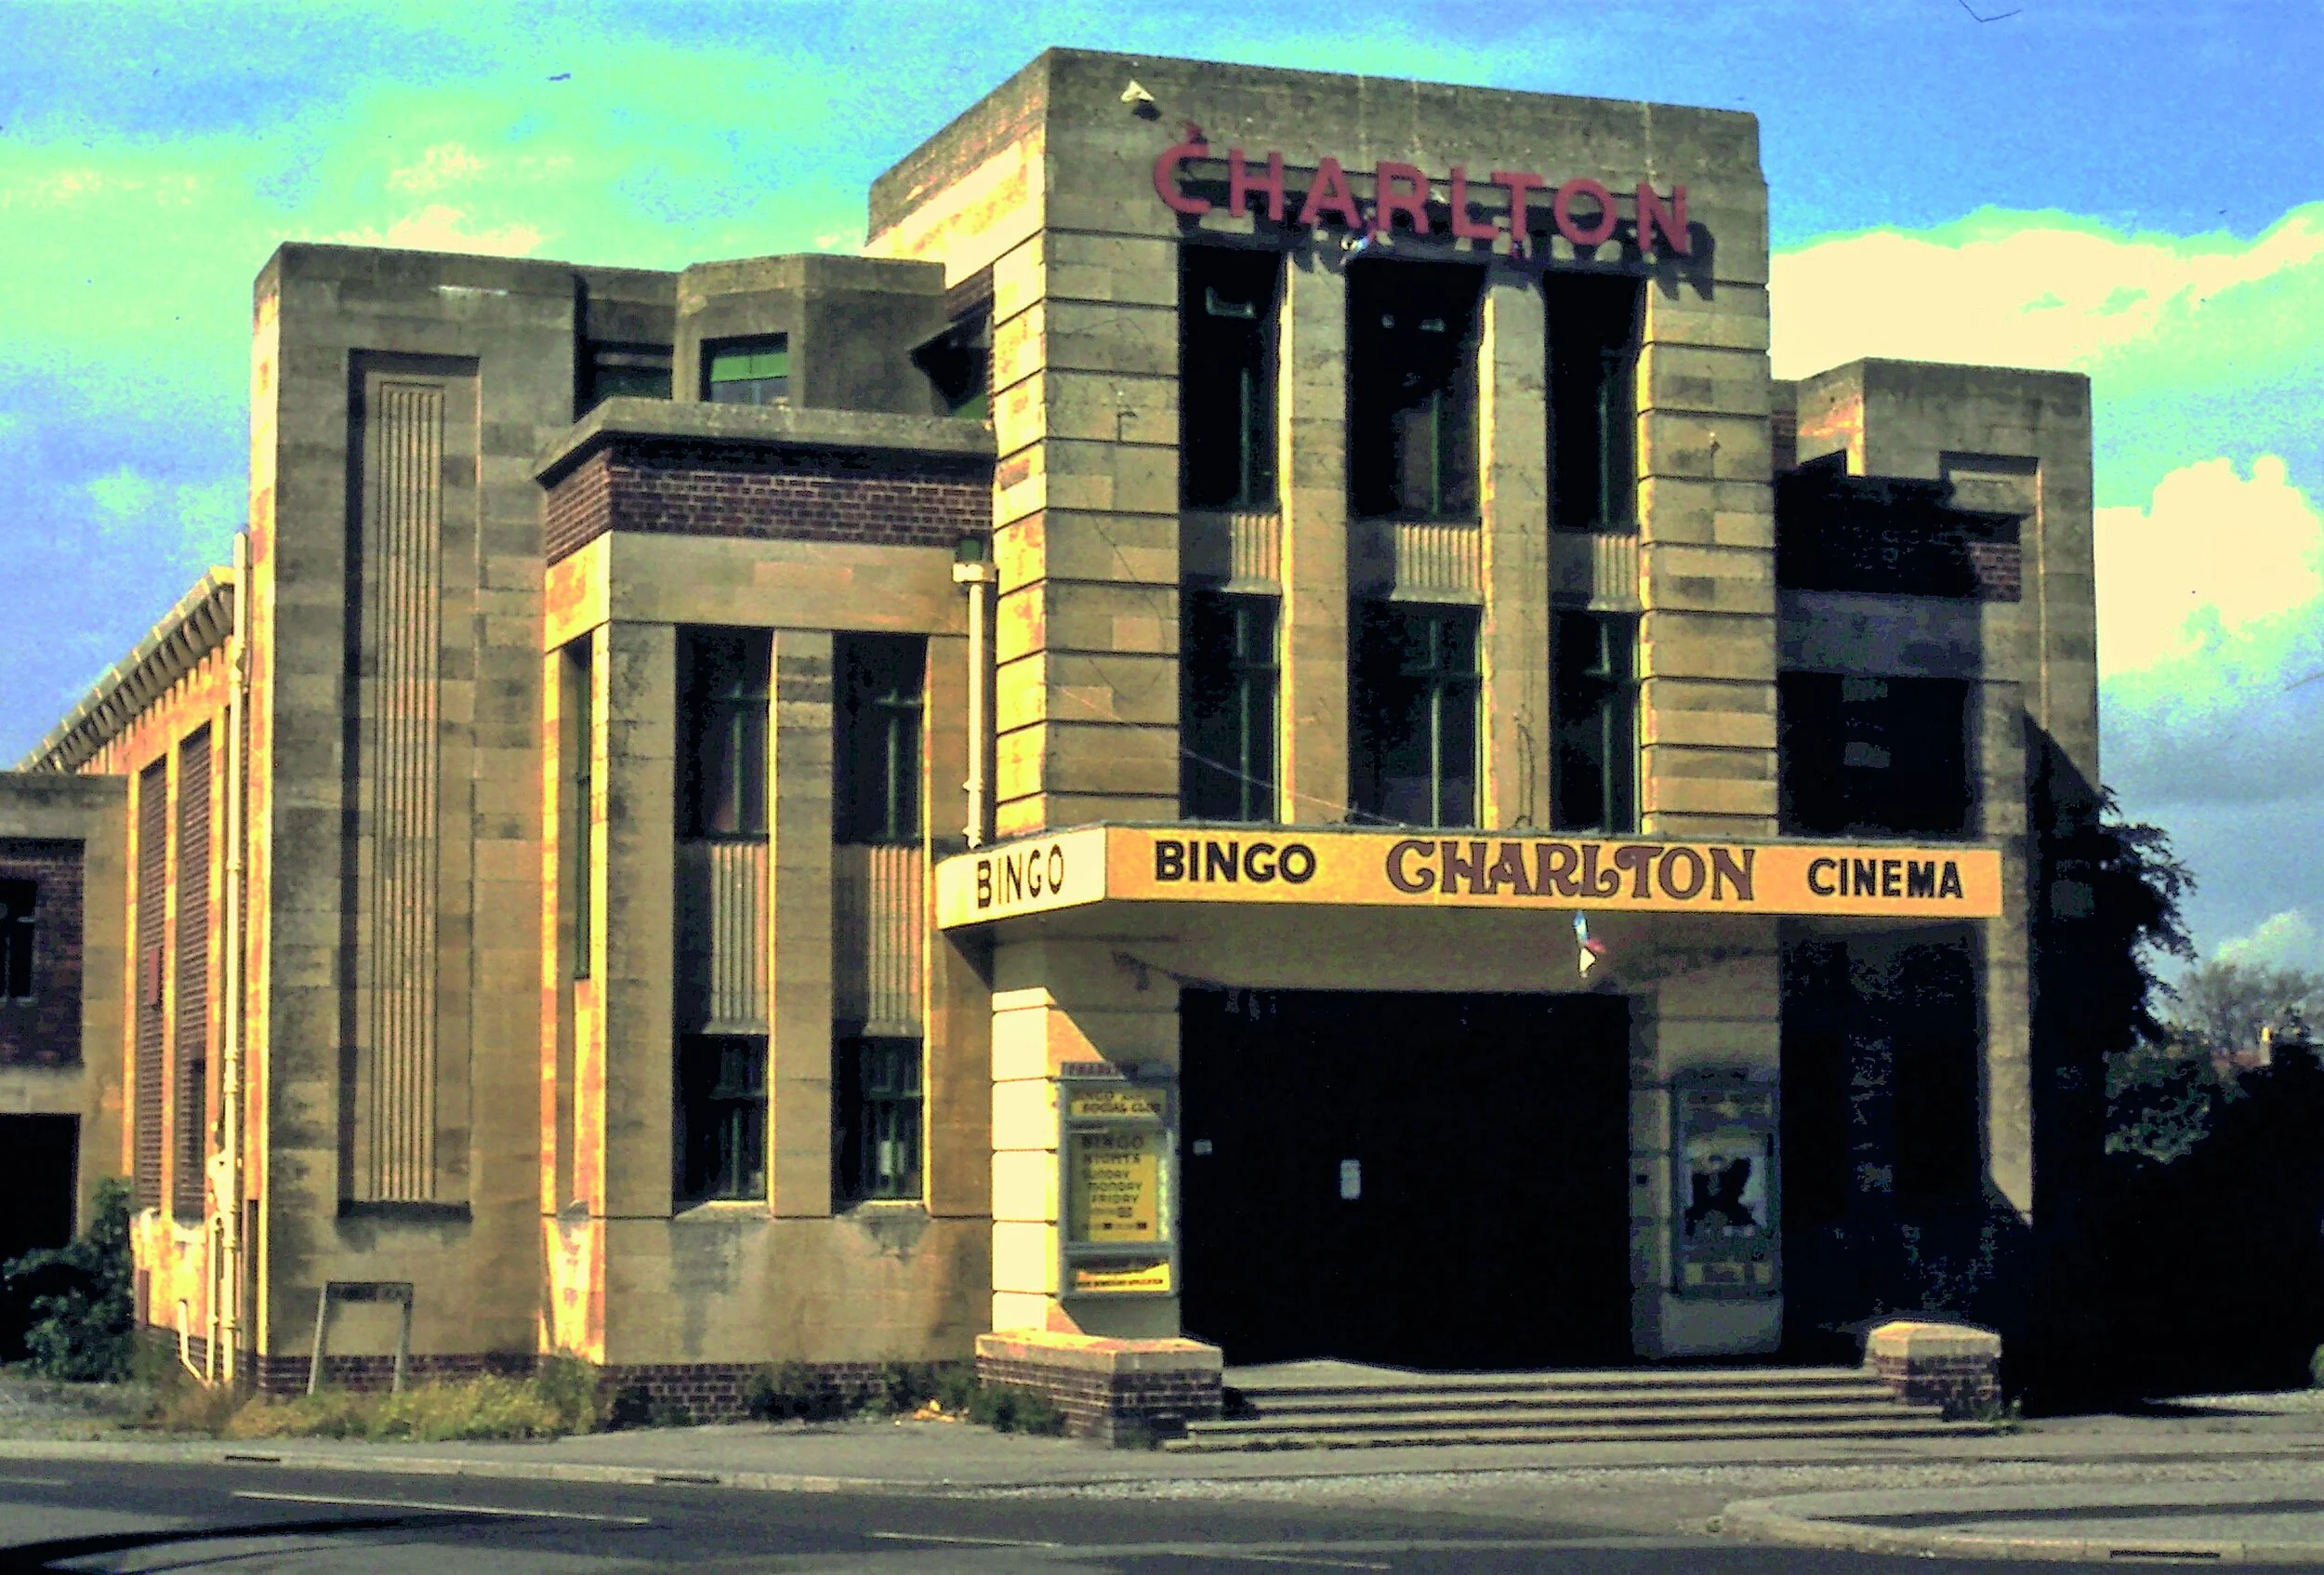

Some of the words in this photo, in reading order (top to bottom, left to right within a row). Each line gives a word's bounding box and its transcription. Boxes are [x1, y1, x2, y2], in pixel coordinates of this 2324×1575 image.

[1154, 142, 1689, 255] CHARLTON
[976, 843, 1064, 910] BINGO
[1155, 840, 1317, 884] BINGO
[1386, 840, 1757, 902] CHARLTON
[1807, 857, 1964, 899] CINEMA
